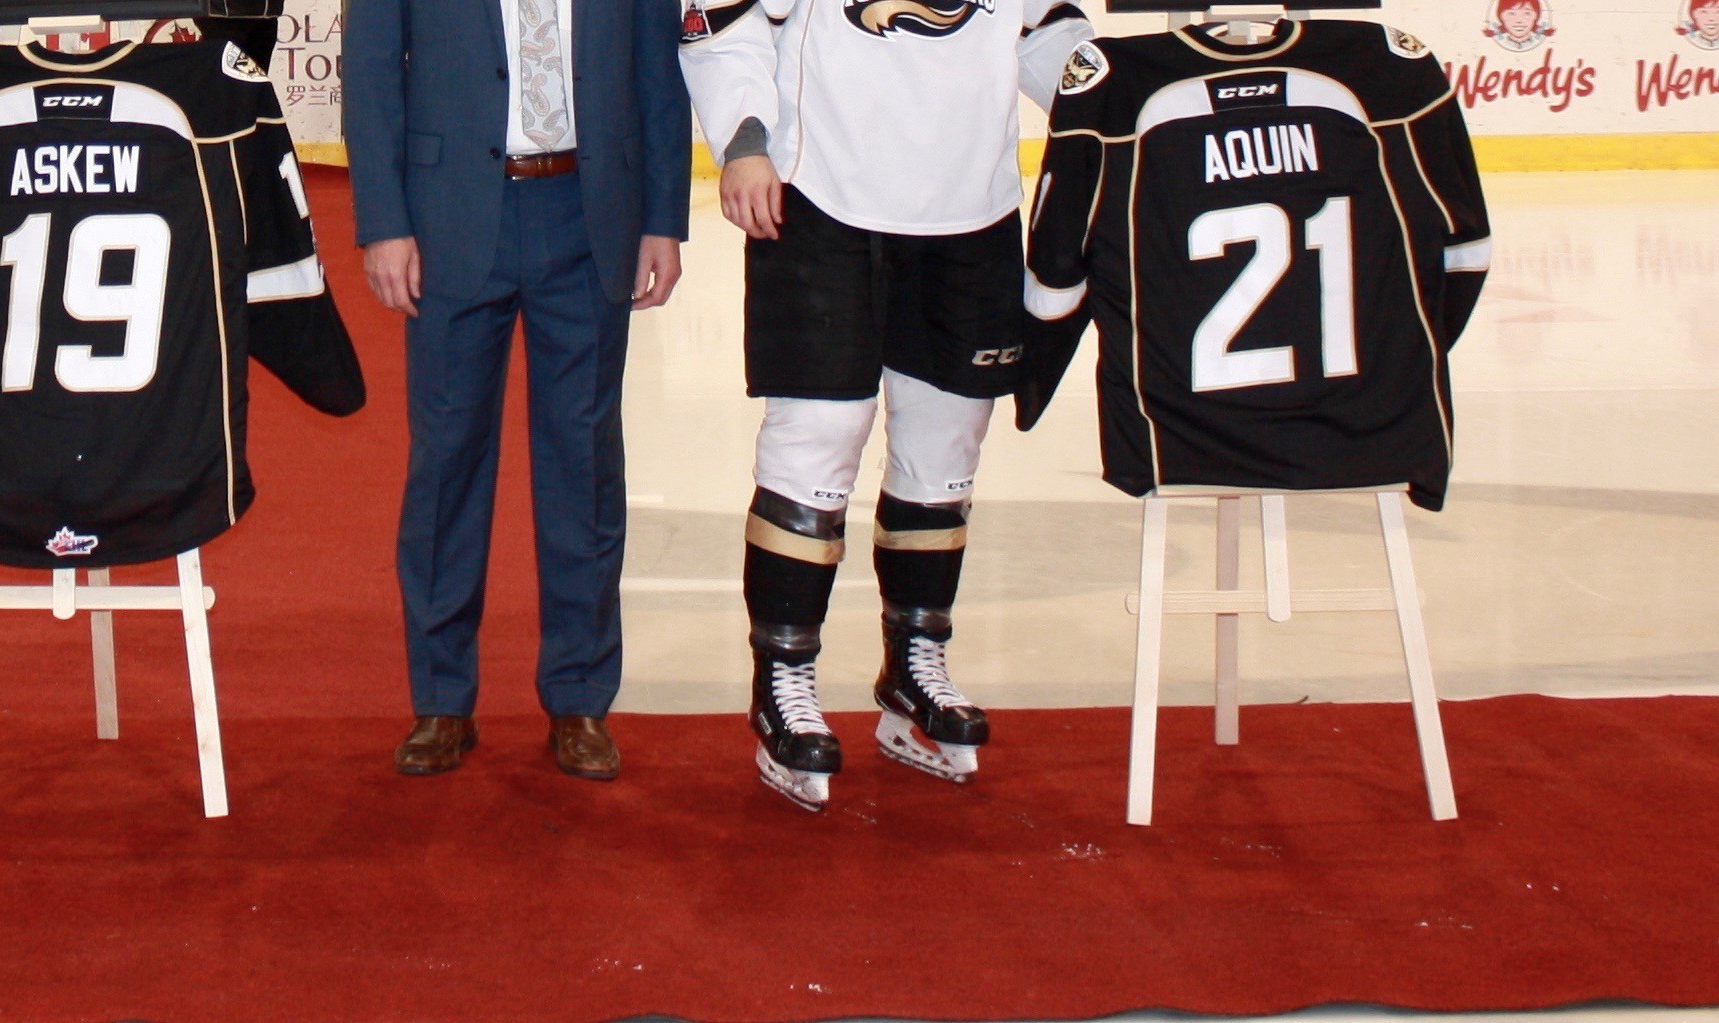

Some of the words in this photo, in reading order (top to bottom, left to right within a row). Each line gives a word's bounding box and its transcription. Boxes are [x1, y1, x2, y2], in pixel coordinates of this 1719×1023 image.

[42, 95, 103, 108] CCM
[1217, 82, 1279, 99] CCM
[1444, 48, 1596, 113] Wendy's
[9, 144, 140, 197] ASKEW
[1204, 123, 1319, 183] AQUIN
[0, 212, 172, 393] 19
[1187, 195, 1359, 393] 21
[971, 345, 1023, 366] CC
